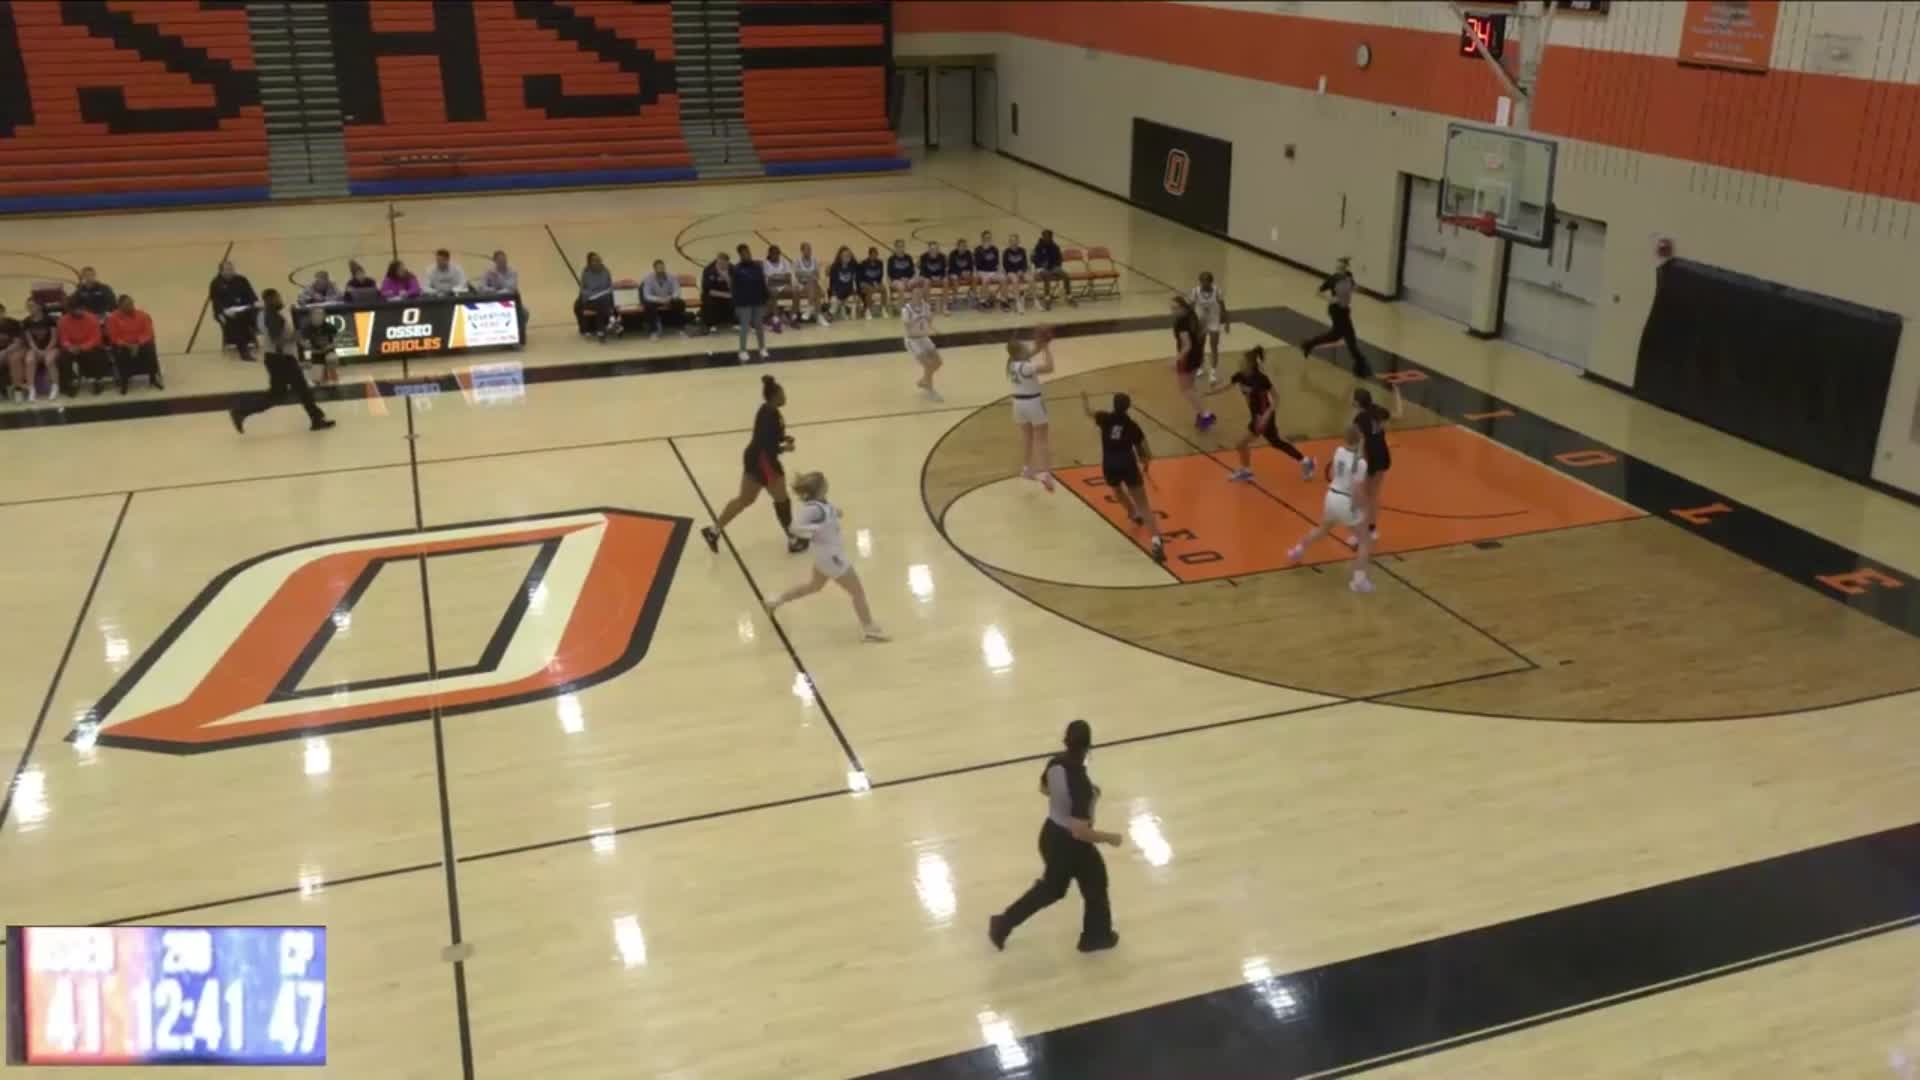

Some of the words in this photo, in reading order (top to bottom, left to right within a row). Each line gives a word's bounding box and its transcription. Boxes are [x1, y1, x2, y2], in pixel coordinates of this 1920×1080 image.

[1464, 18, 1492, 52] 34
[386, 324, 432, 339] OSSEO
[381, 337, 441, 353] ORIOLES
